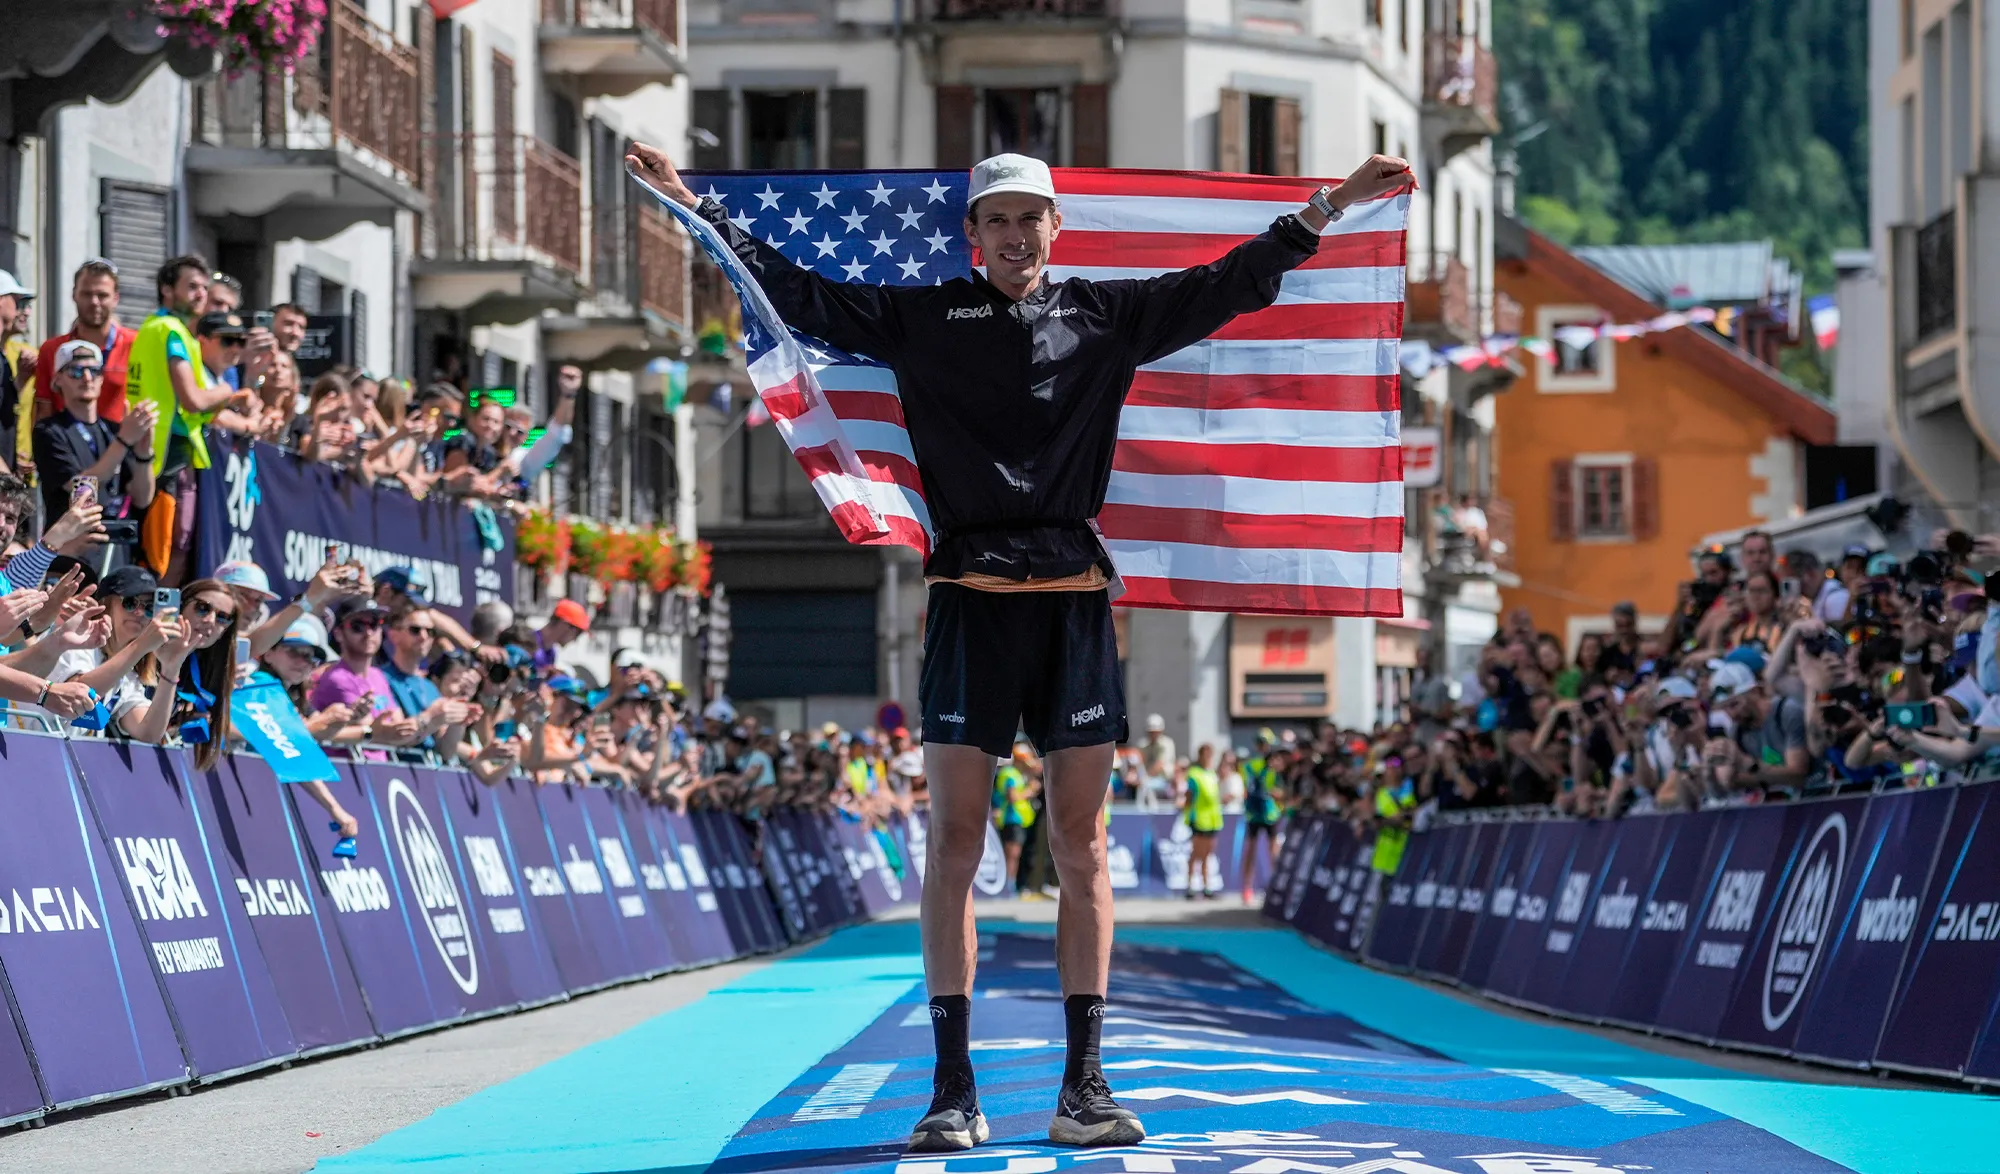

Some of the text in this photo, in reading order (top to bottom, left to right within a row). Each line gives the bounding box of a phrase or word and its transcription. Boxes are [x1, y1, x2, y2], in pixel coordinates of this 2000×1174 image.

[946, 303, 994, 320] HOKA
[245, 702, 302, 760] HOKA
[938, 711, 966, 724] wahoo
[1071, 703, 1105, 728] HOKA
[113, 836, 209, 921] HOKA
[235, 878, 312, 917] DACIA
[321, 856, 391, 913] wahoo
[1856, 874, 1917, 942] wahoo
